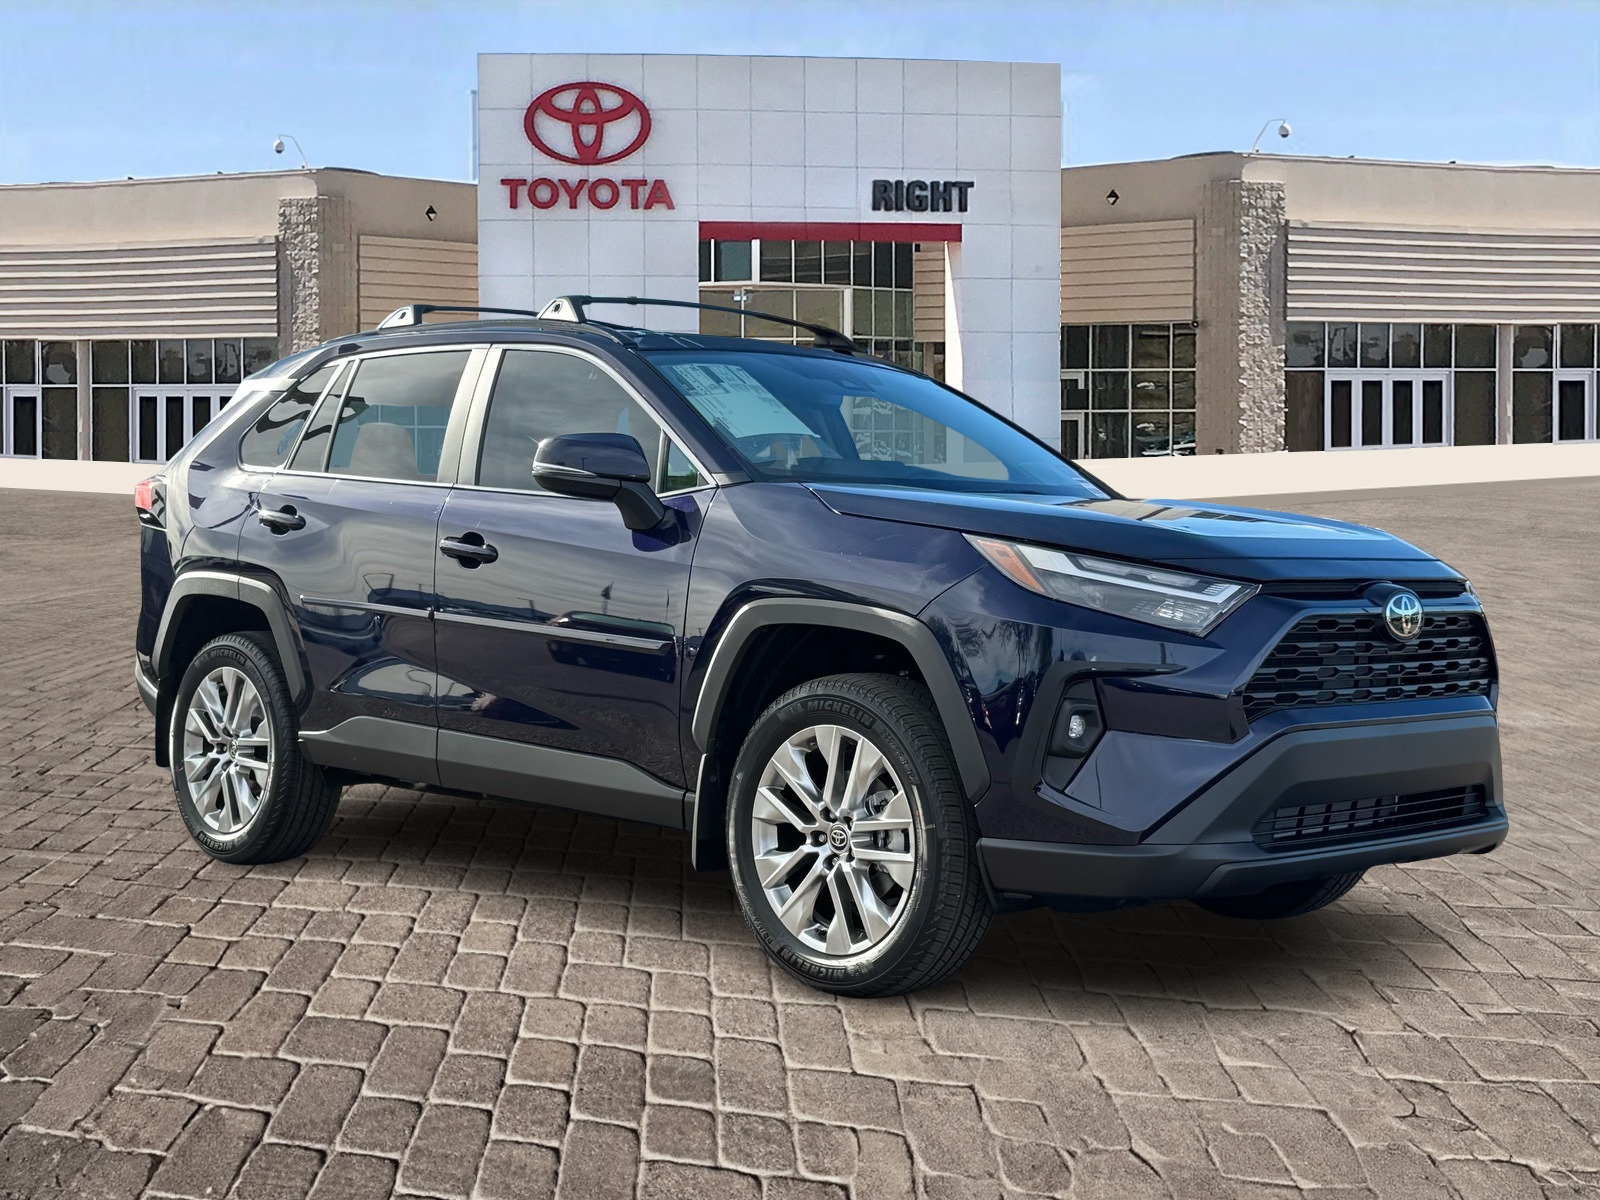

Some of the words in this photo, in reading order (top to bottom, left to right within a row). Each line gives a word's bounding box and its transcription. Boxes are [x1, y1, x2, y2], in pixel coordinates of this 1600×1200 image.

[501, 178, 674, 209] TOYOTA
[872, 180, 974, 212] RIGHT
[210, 649, 246, 665] MICHELIN
[807, 700, 873, 726] MICHELIN
[780, 947, 845, 977] MICHELIN
